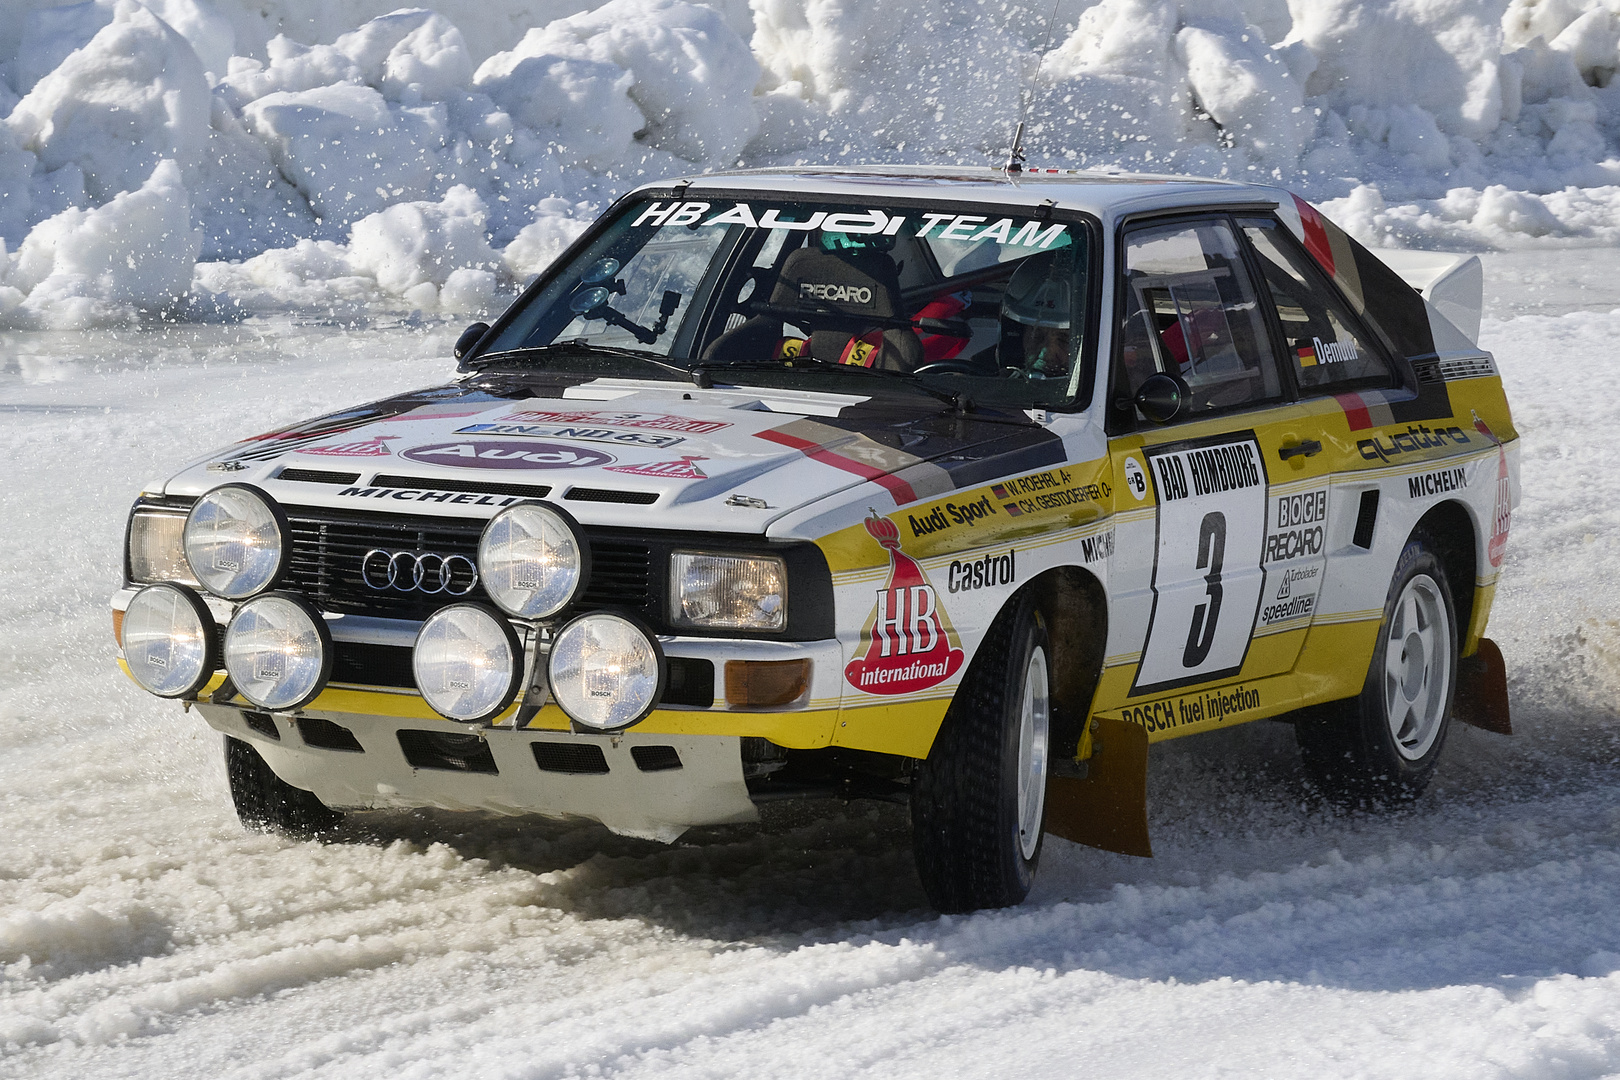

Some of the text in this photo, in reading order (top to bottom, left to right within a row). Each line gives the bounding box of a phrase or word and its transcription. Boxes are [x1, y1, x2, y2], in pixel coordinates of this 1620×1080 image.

[631, 202, 711, 227] HB
[915, 213, 1067, 249] TEAM
[799, 283, 872, 304] RECARO
[1356, 424, 1471, 464] quattro
[1133, 471, 1146, 493] B
[1156, 443, 1260, 502] BAD HOMBOURG
[1408, 468, 1467, 499] MICHELIN
[338, 487, 517, 507] MICHELI
[1278, 490, 1326, 528] BOGE
[908, 495, 997, 538] Audi Sport
[1265, 526, 1323, 563] RECARO
[218, 560, 239, 569] BOSCH
[948, 549, 1015, 594] Castrol
[517, 580, 538, 588] BOSCH
[1182, 511, 1227, 669] 3
[876, 584, 938, 658] HB
[1262, 595, 1311, 625] speedline
[260, 670, 279, 678] BOSCH
[450, 680, 469, 689] BOSCH
[860, 656, 950, 686] international
[591, 690, 612, 698] BOSCH
[1178, 696, 1205, 725] fuel
[1205, 686, 1261, 722] injection
